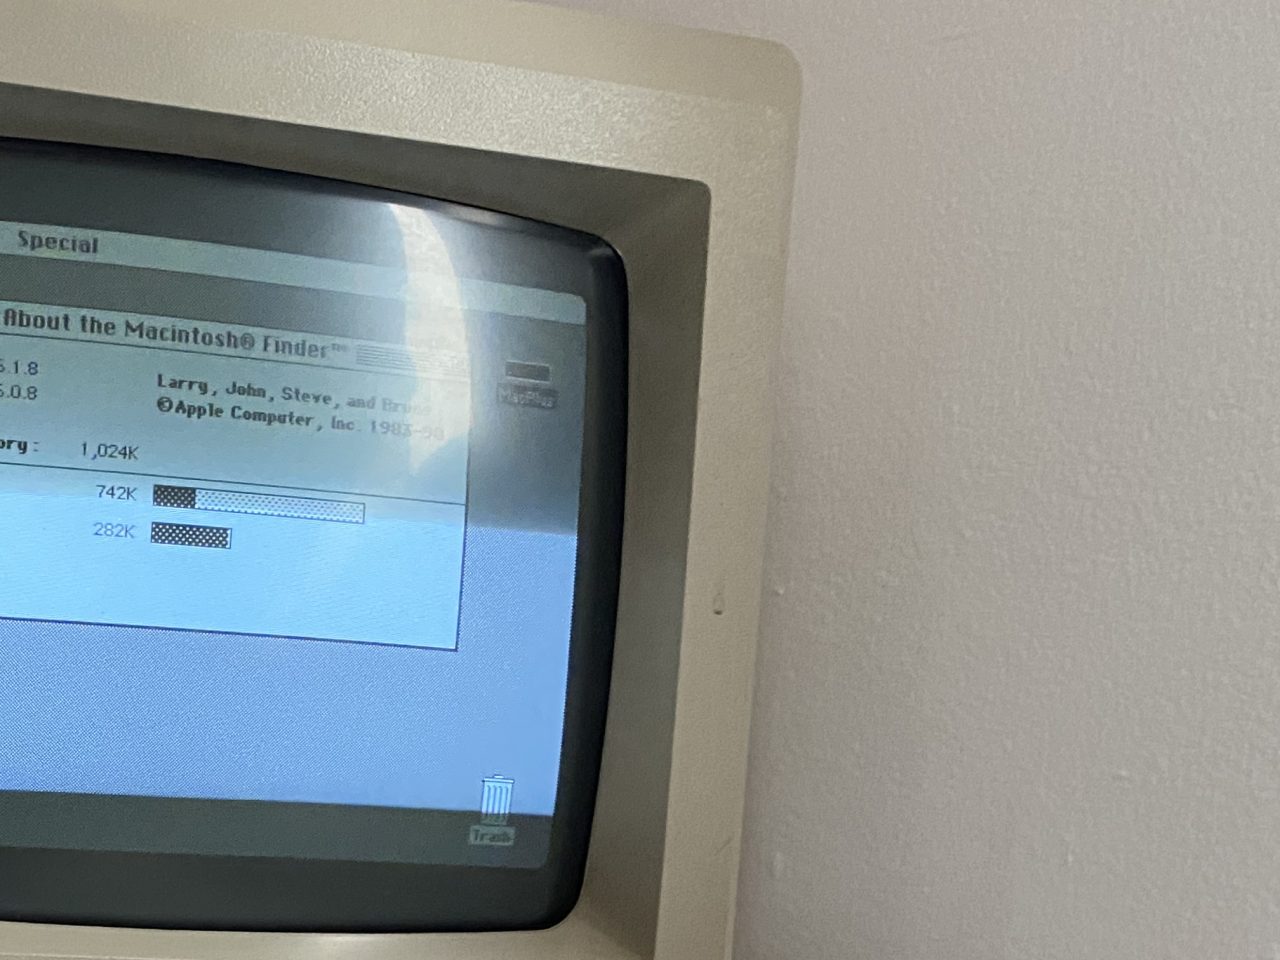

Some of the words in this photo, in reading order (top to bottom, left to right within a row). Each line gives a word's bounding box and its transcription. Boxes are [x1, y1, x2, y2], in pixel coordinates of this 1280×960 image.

[18, 230, 99, 255] Special
[3, 308, 71, 332] About
[81, 315, 116, 336] the
[157, 373, 218, 398] Larry,
[226, 381, 275, 403] John,
[281, 387, 339, 410] Steve,
[346, 396, 377, 410] and
[230, 403, 323, 431] Computer,
[331, 416, 362, 432] Inc.
[81, 441, 139, 461] 1,024K
[95, 484, 138, 501] 742K
[92, 521, 136, 539] 282K
